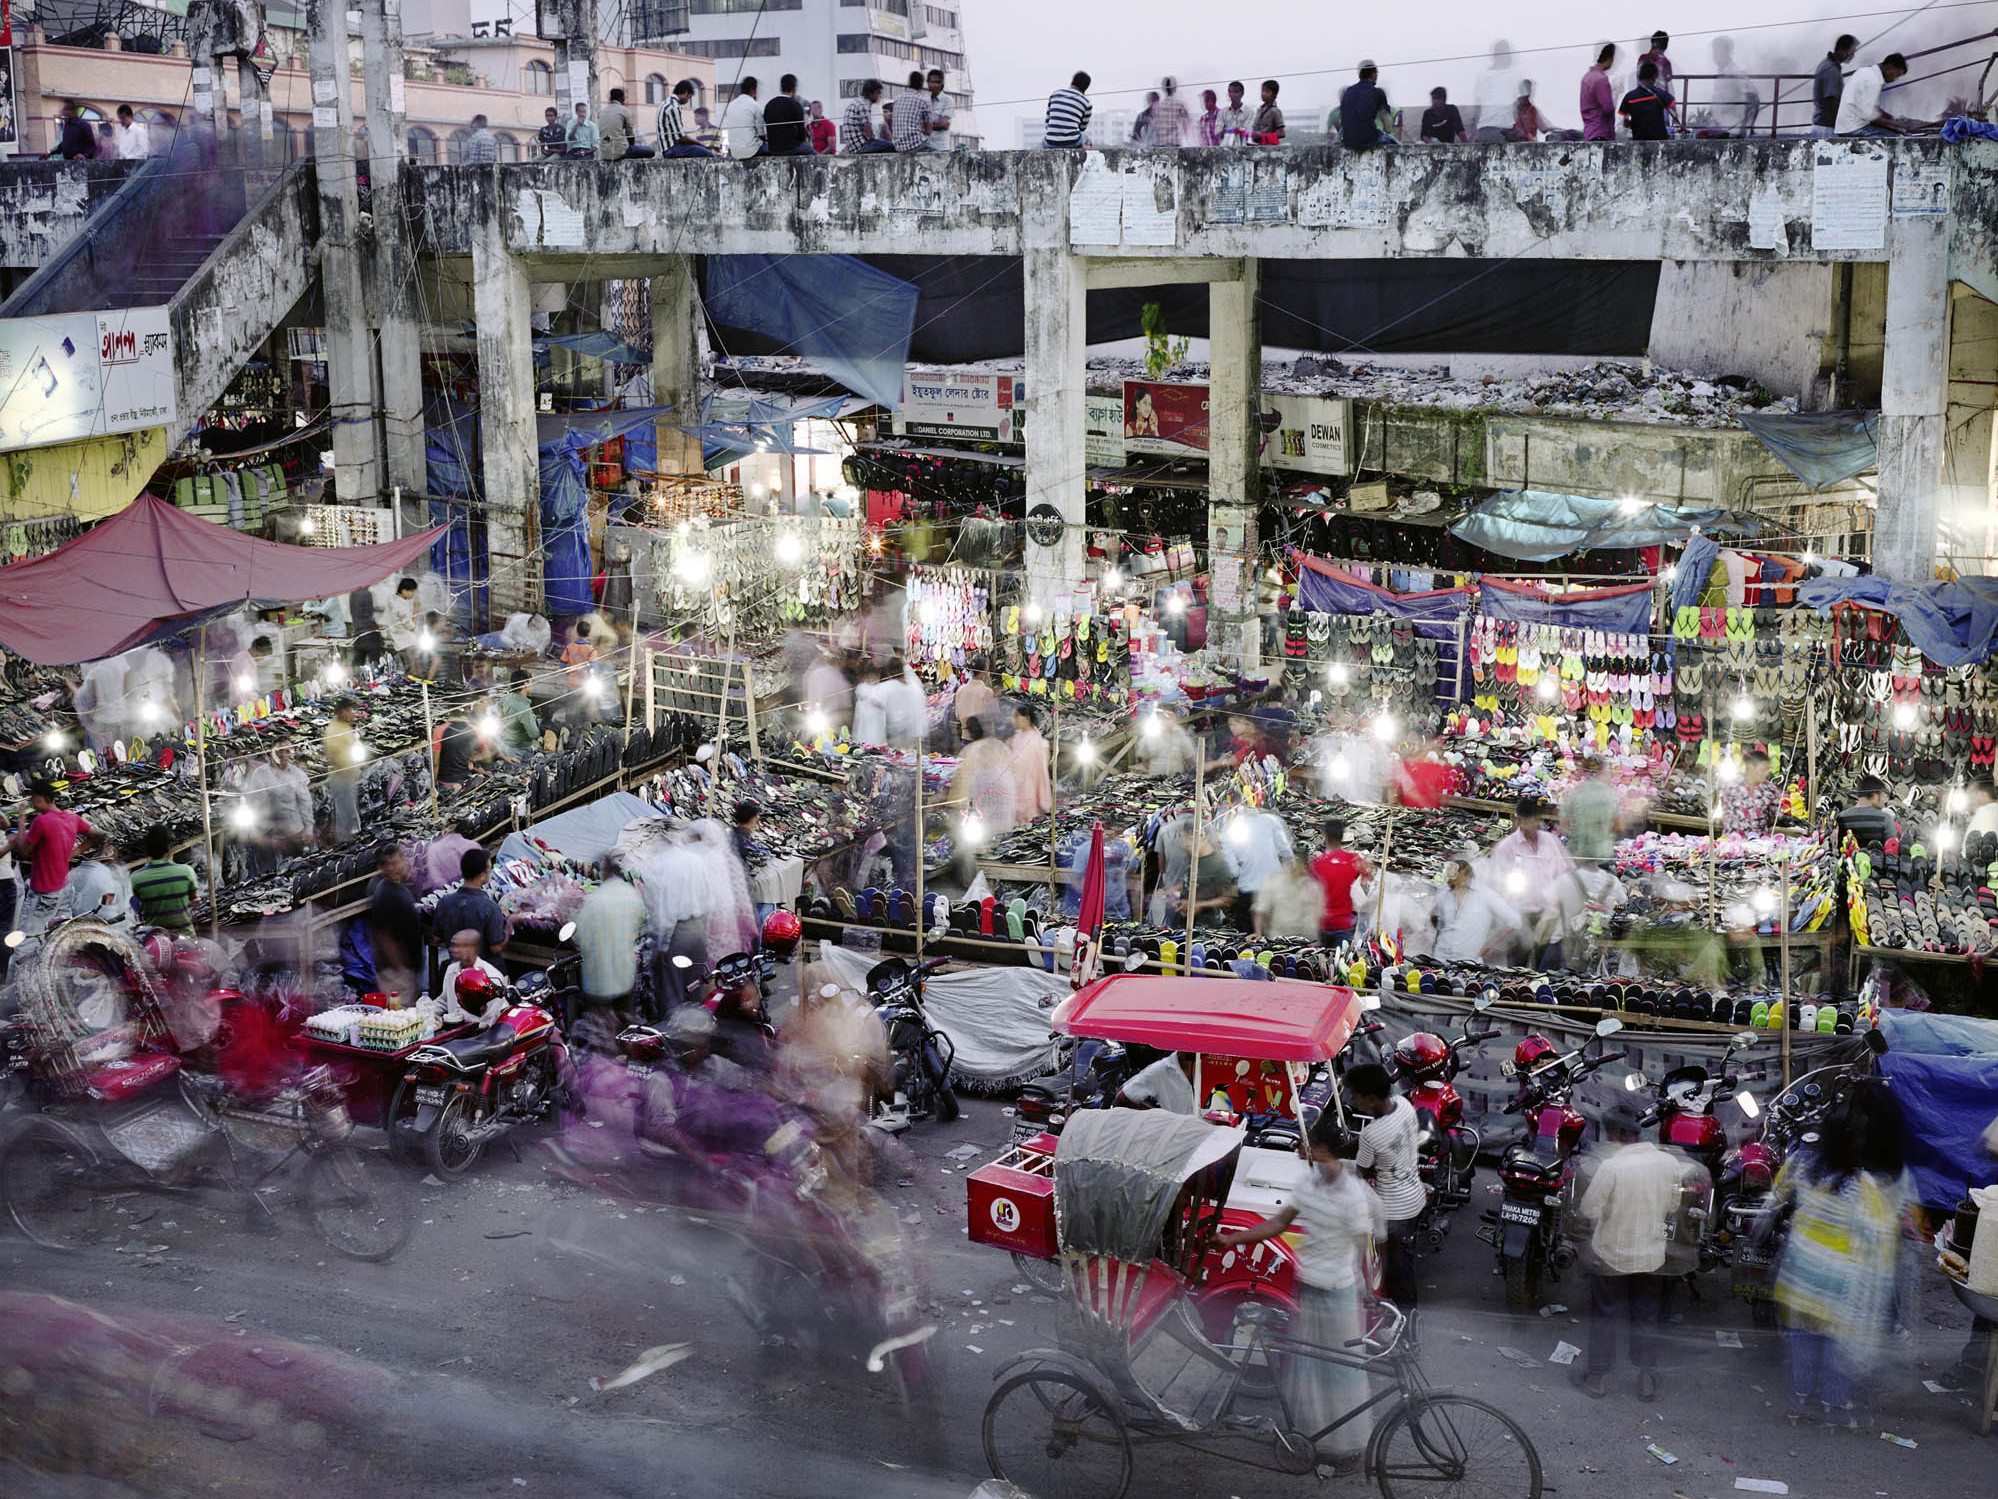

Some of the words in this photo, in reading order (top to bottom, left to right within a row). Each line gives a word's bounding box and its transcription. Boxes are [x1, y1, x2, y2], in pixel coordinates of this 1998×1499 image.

[1087, 407, 1108, 422] ব্যাগ
[918, 425, 937, 434] DANIEL
[938, 427, 979, 438] CORPORATION
[979, 429, 993, 438] LTD.
[1311, 423, 1341, 442] DEWAN
[1311, 442, 1342, 451] COSMETICS
[1502, 1203, 1521, 1214] DHAKA
[1521, 1207, 1541, 1218] METRO
[1501, 1212, 1538, 1225] LA-11-7206
